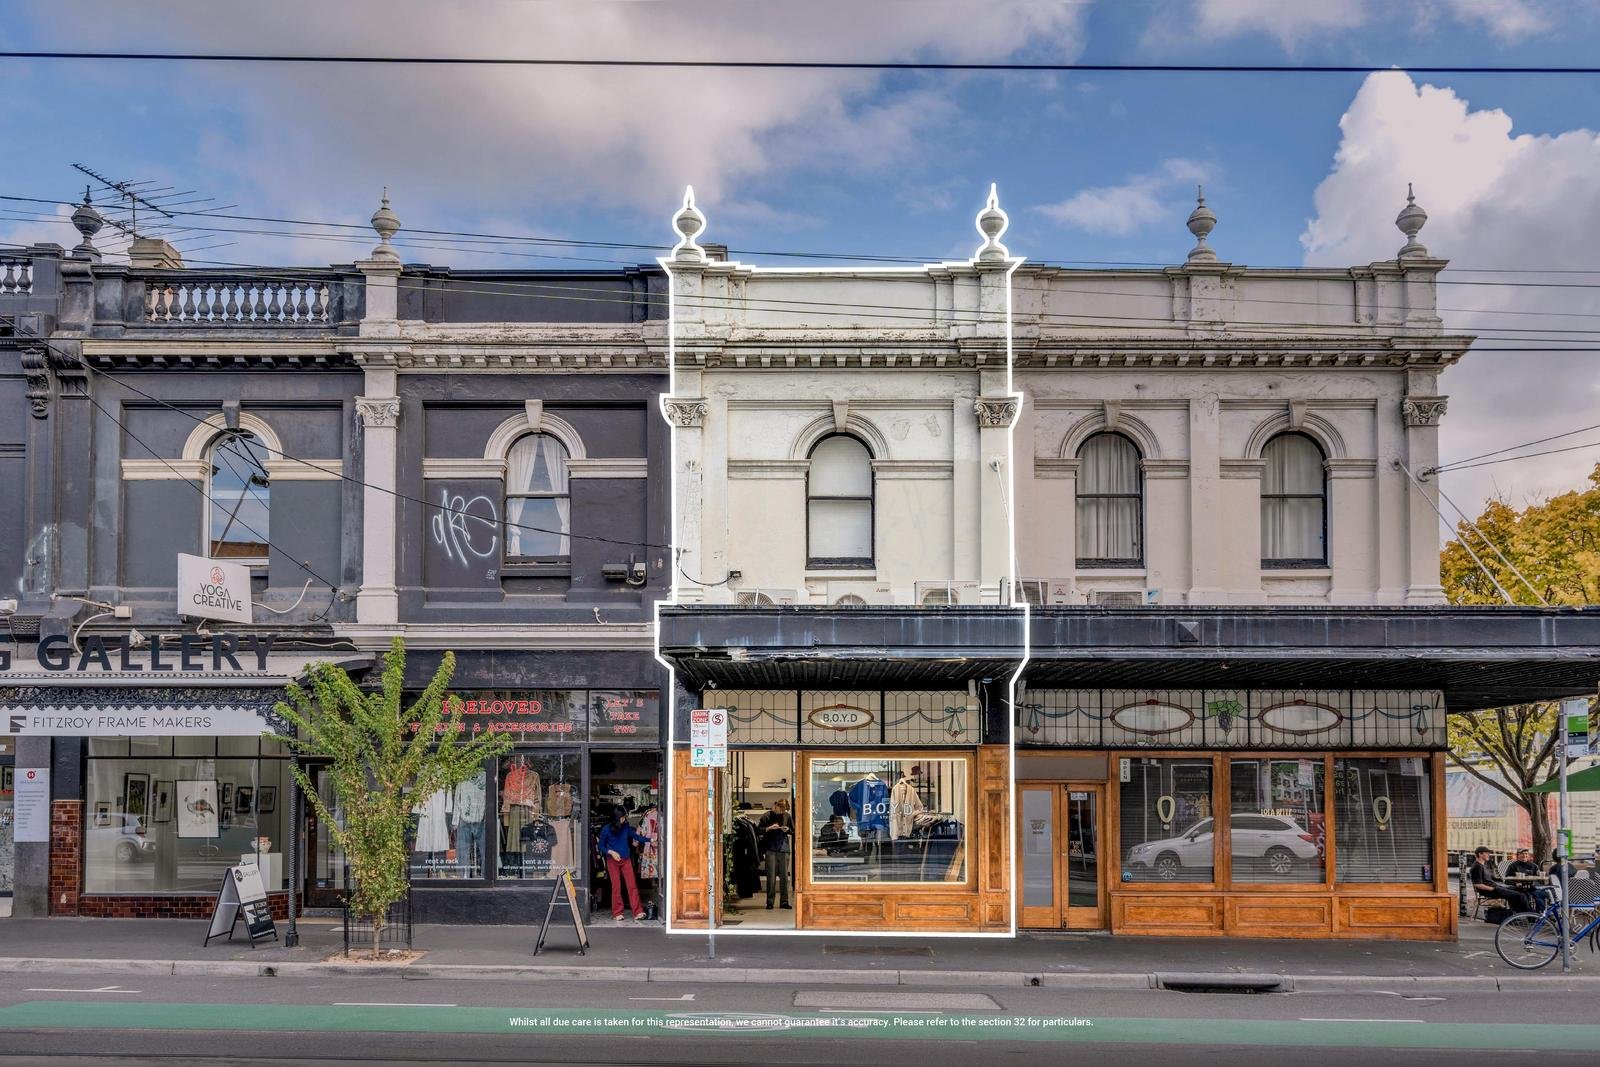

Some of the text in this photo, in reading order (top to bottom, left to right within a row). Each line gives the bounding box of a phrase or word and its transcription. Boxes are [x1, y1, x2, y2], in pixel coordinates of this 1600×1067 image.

[199, 584, 231, 600] YOGA
[193, 593, 243, 612] CREATIVE
[37, 634, 278, 672] GALLERY
[33, 716, 212, 729] FITZROY FRAME MAKERS
[823, 713, 858, 723] B.O.Y.D
[488, 722, 573, 733] ACCESSORIES
[696, 749, 704, 758] P
[863, 803, 913, 816] B.O.Y.D
